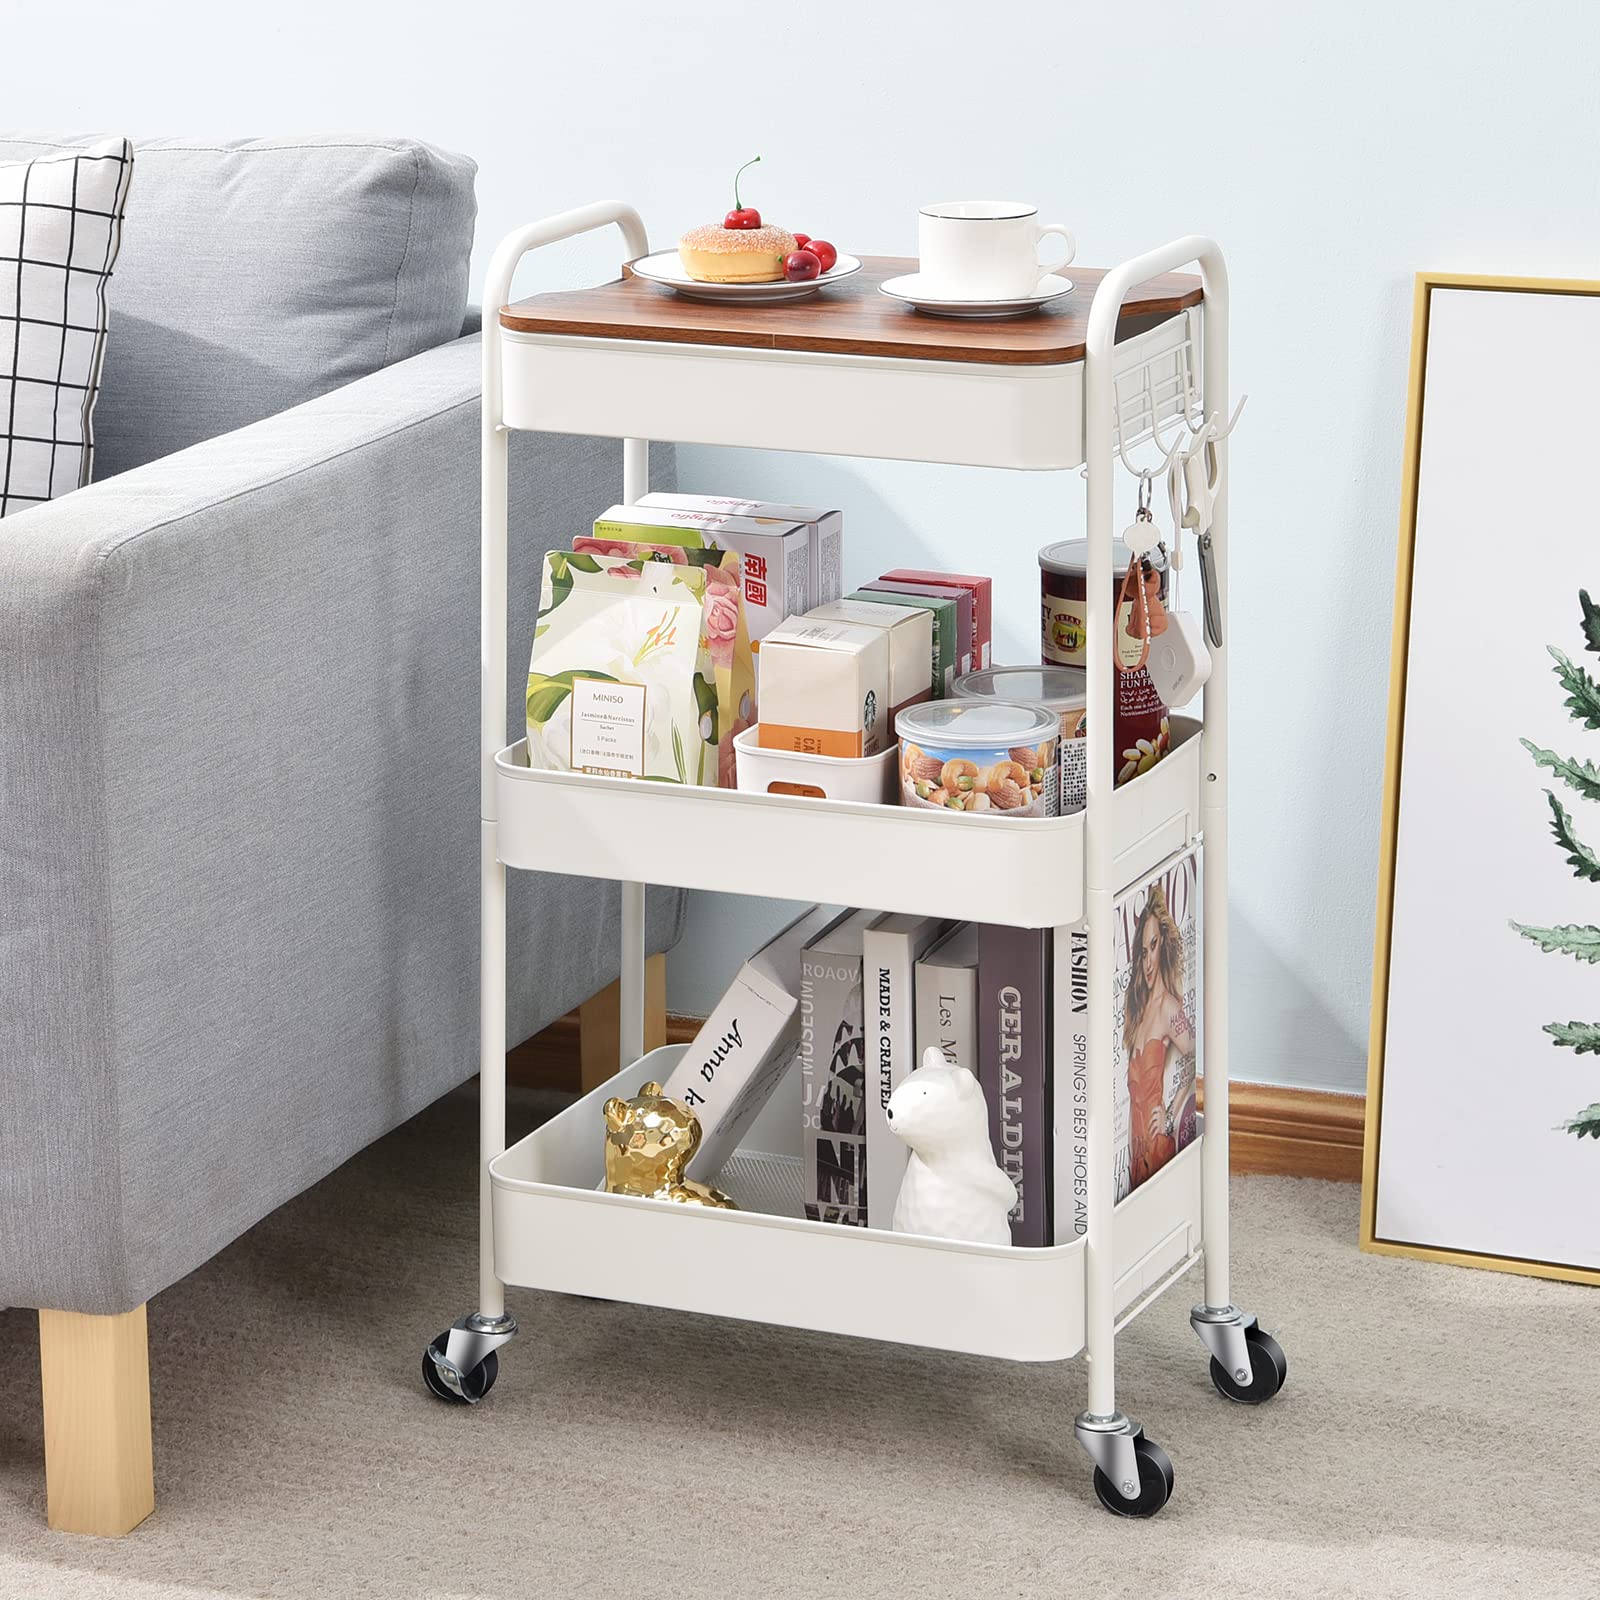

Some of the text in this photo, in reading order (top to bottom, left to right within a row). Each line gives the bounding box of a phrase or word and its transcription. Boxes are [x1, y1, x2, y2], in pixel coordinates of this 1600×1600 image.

[592, 692, 624, 704] MINISO
[1120, 679, 1140, 689] FUN
[801, 981, 814, 1076] MUSEUM
[879, 968, 892, 1111] MADE & CRAFTED
[939, 995, 956, 1027] Les
[700, 1018, 744, 1083] Anna
[1071, 931, 1088, 1235] FASHION SPRING'S BEST SHOES AND
